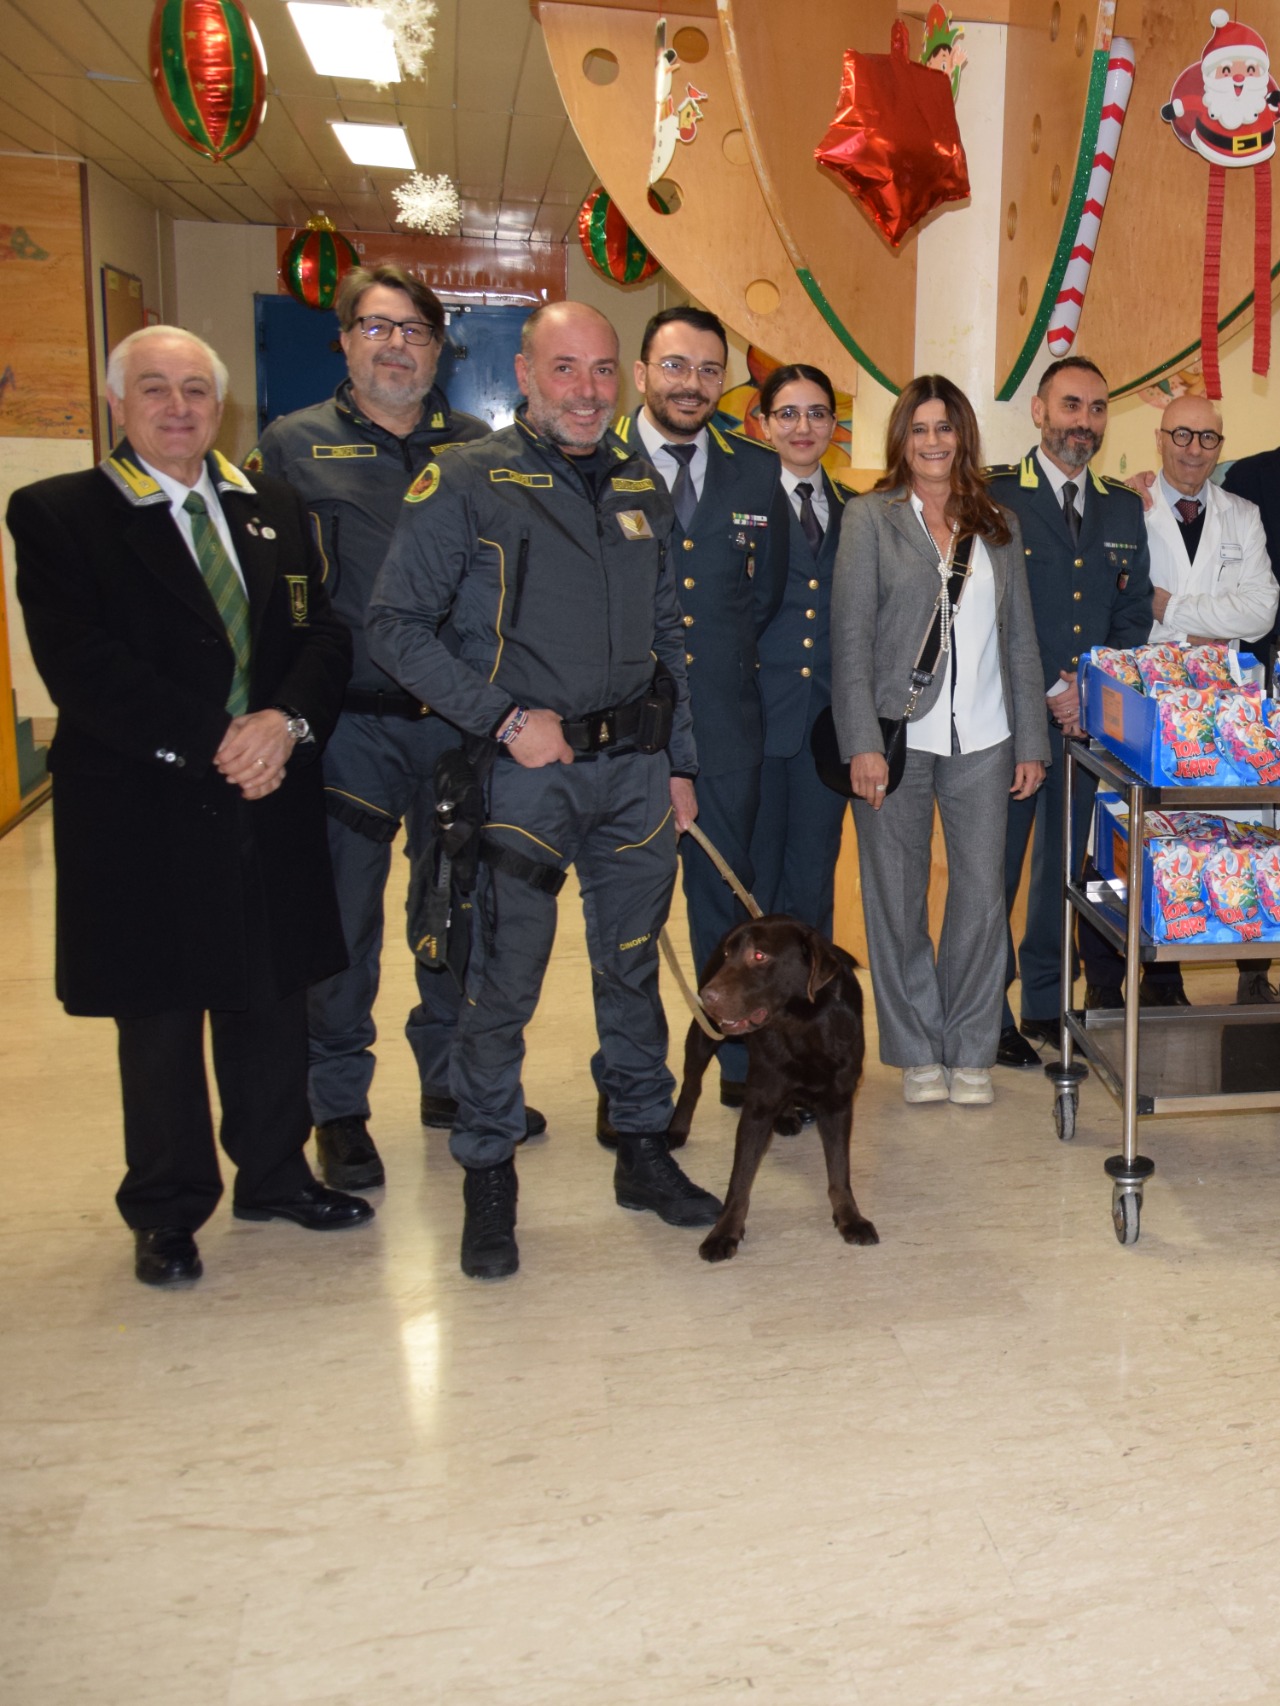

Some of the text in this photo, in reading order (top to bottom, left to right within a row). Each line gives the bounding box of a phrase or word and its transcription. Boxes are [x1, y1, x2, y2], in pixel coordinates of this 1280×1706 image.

[1171, 740, 1201, 759] TOM
[1246, 750, 1275, 769] TOM
[1173, 757, 1220, 778] JERRY
[1163, 901, 1190, 922] TOM
[1214, 905, 1245, 925] TOM
[1164, 915, 1207, 940] JERRY
